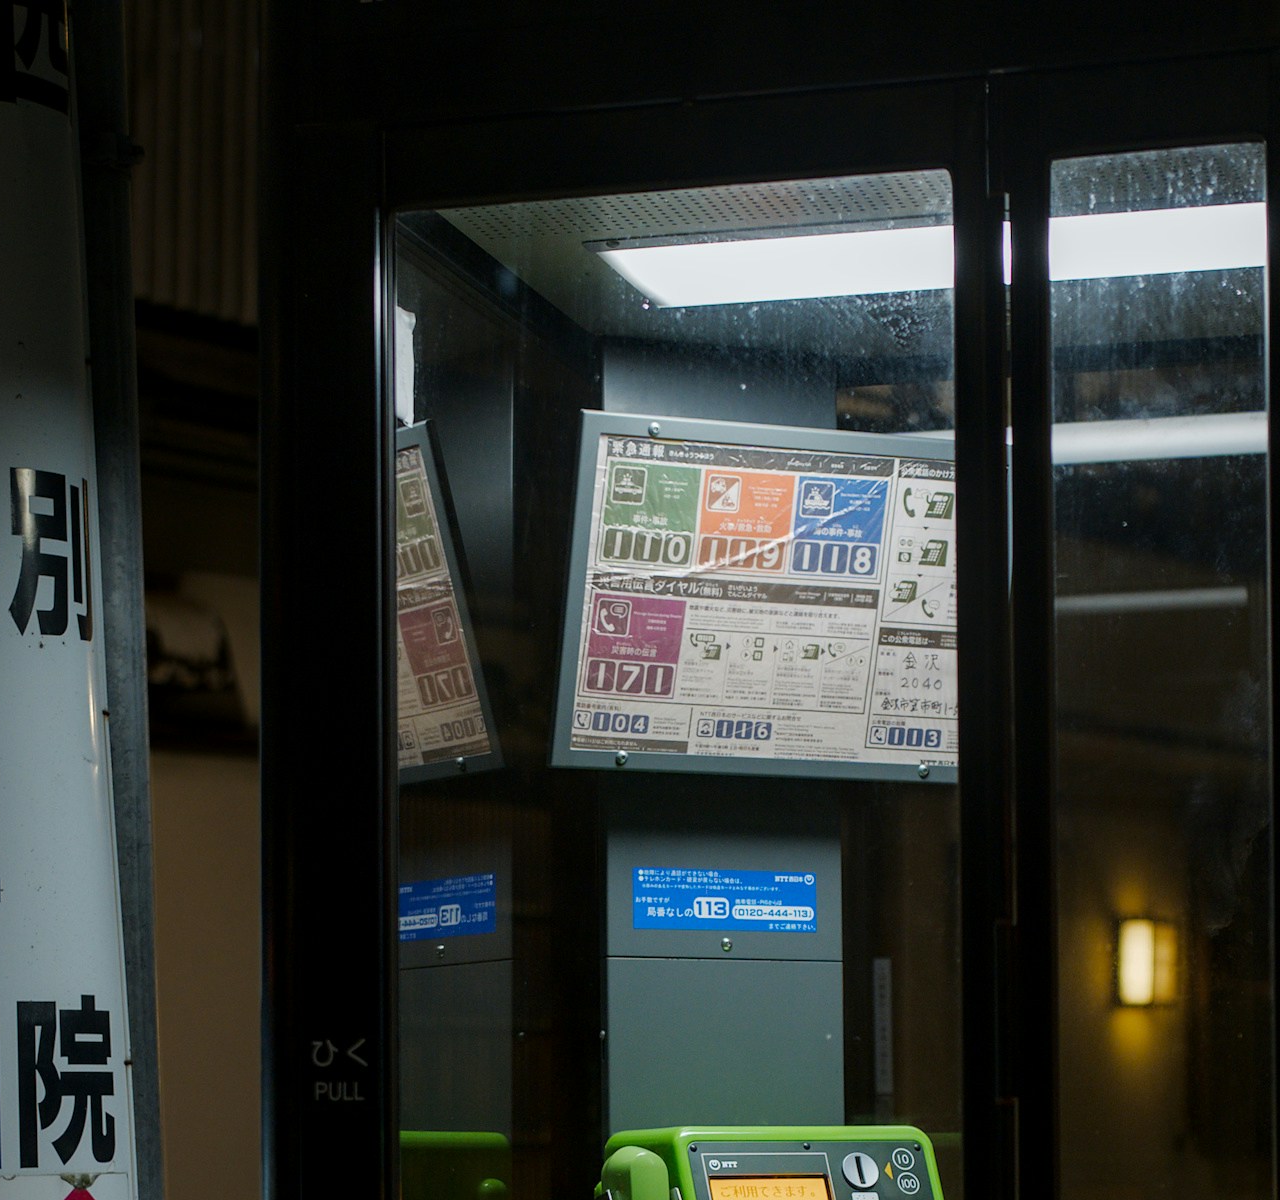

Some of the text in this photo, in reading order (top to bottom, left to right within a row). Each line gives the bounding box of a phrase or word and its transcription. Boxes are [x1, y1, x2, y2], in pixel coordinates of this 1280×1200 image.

[612, 440, 665, 458] 緊急通報
[613, 531, 686, 563] 110
[708, 539, 780, 568] 119
[802, 544, 871, 574] 118
[902, 651, 940, 671] 金沢
[596, 662, 665, 693] 171
[900, 677, 942, 690] 2040
[598, 714, 646, 732] 104
[721, 721, 768, 738] 116
[894, 728, 938, 746] 113
[646, 901, 727, 918] 局番なしの 113
[312, 1038, 369, 1067] ひく
[315, 1081, 365, 1101] PULL
[896, 1155, 909, 1165] 10
[901, 1179, 917, 1189] 100
